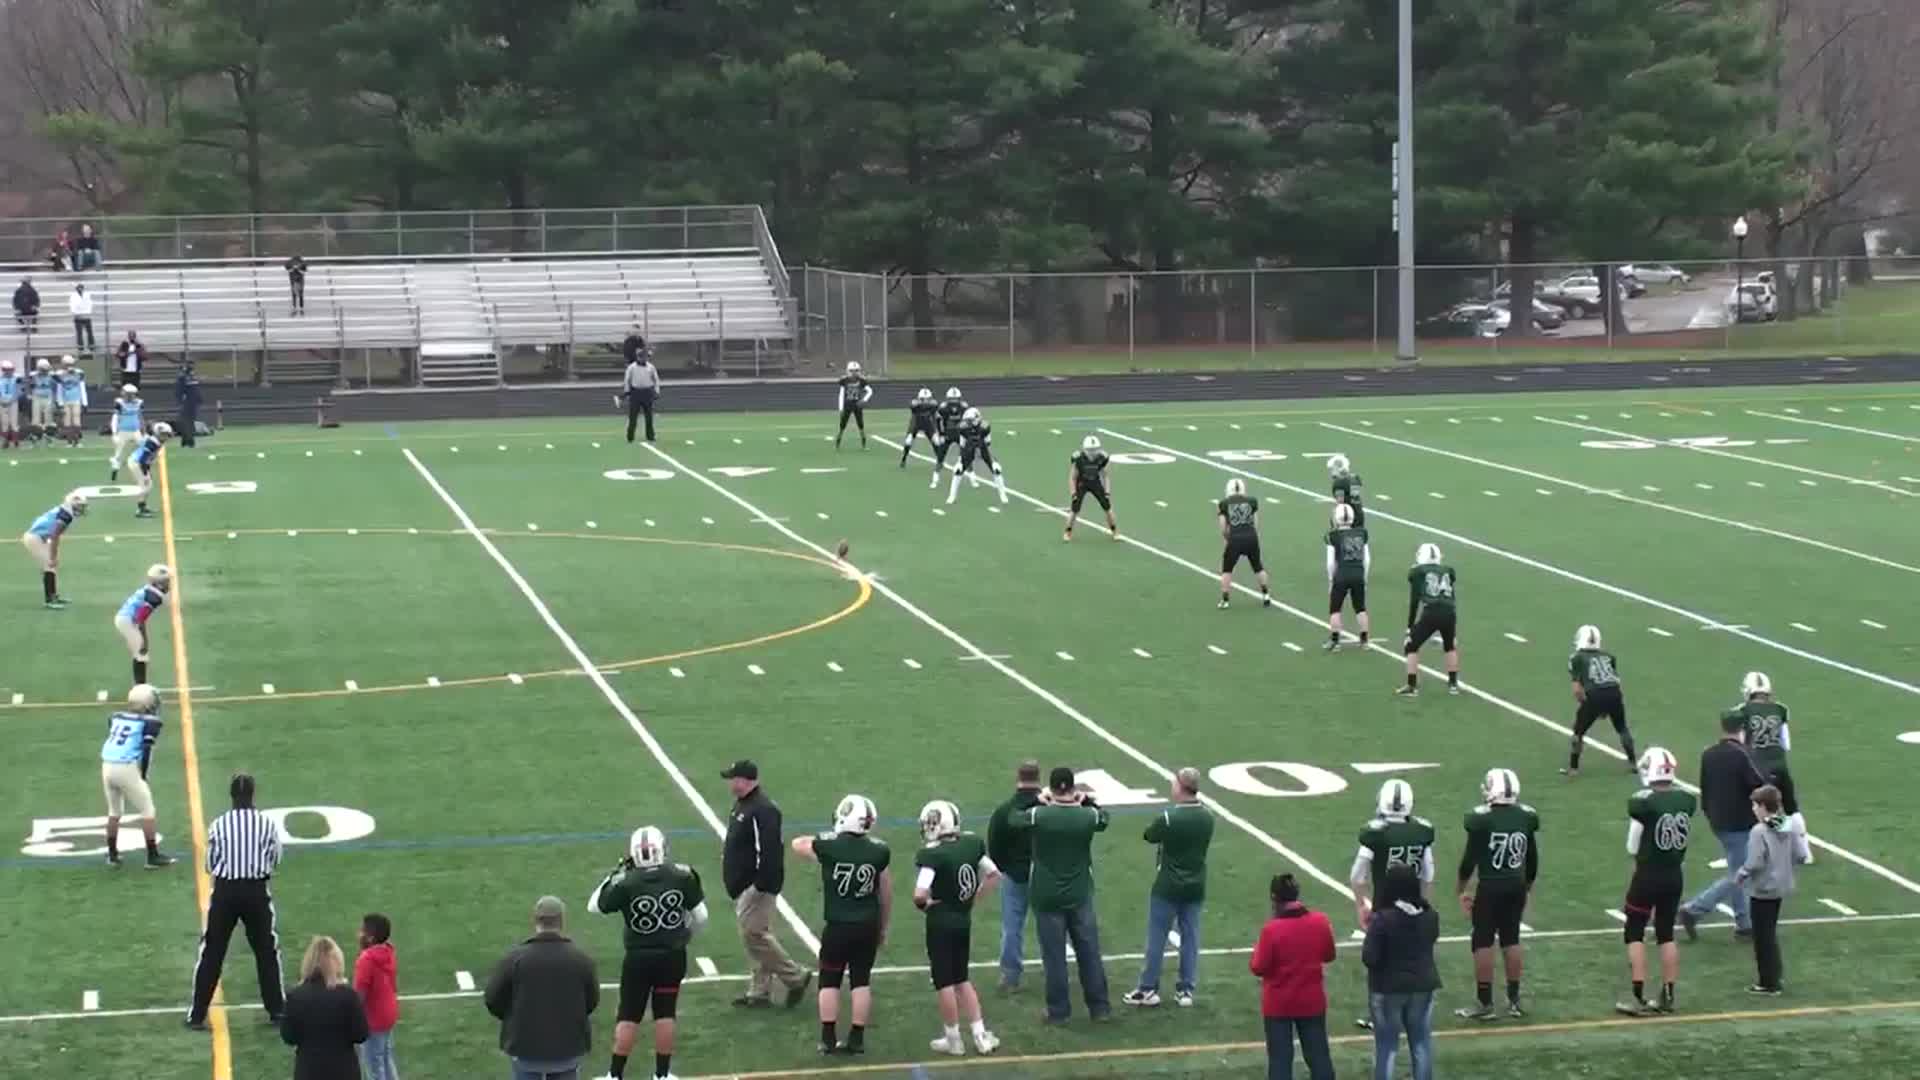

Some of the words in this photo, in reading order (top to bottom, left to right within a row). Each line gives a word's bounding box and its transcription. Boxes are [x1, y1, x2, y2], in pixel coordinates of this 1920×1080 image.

[1488, 832, 1528, 871] 79
[832, 862, 877, 899] 72
[957, 863, 977, 902] 9
[630, 888, 685, 936] 88
